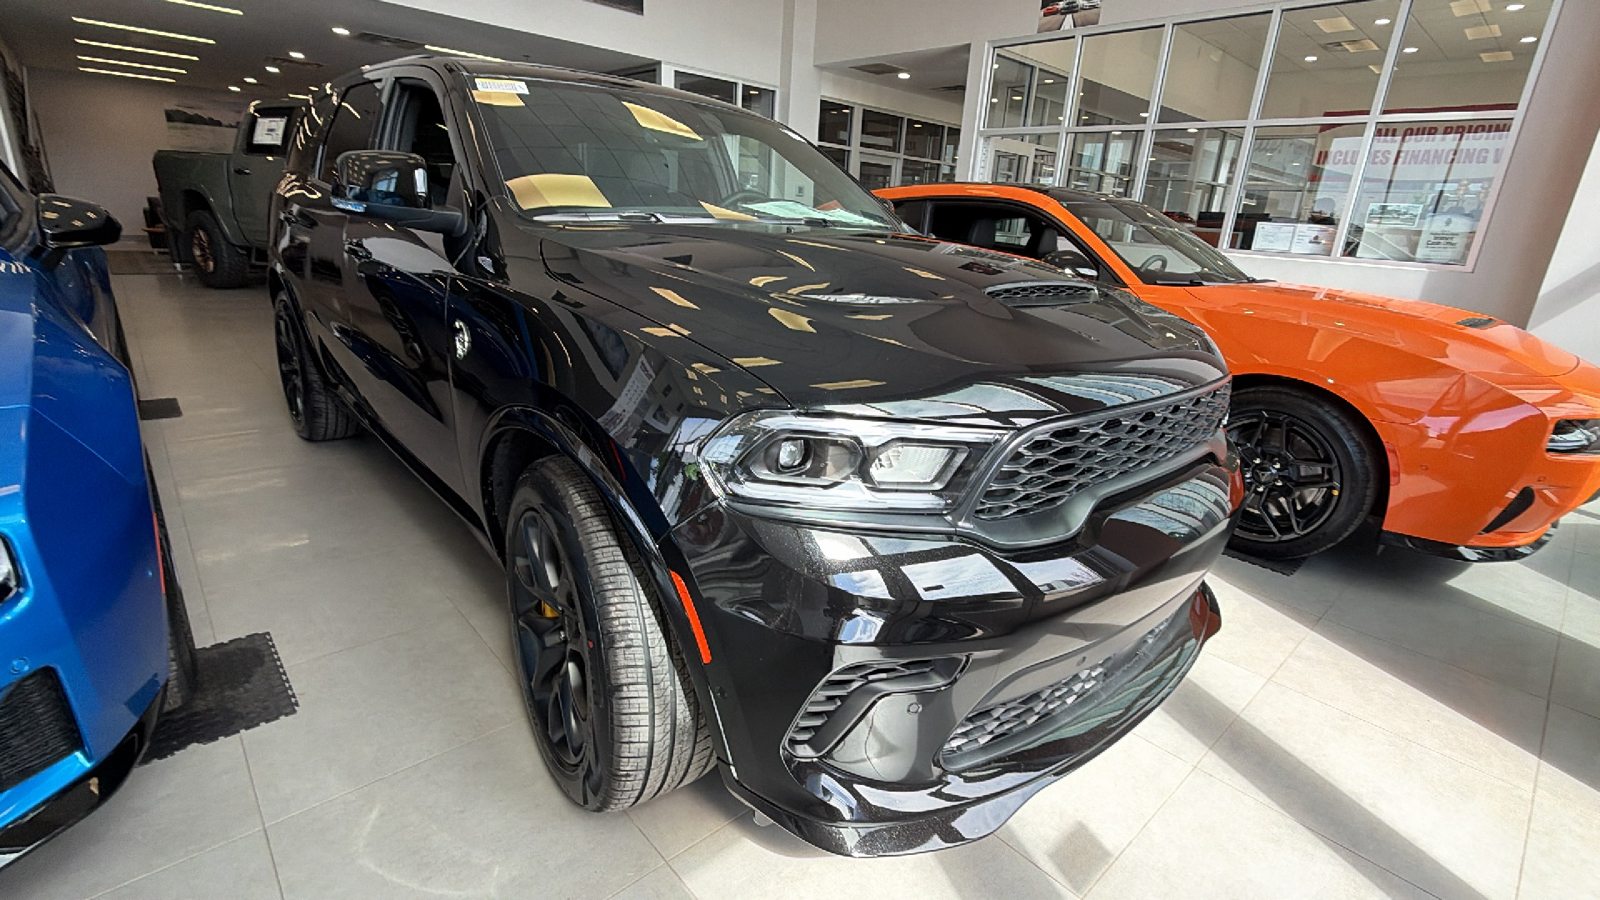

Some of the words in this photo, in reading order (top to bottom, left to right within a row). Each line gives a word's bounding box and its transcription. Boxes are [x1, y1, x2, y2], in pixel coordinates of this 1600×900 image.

[1374, 128, 1398, 143] ALL
[1401, 127, 1438, 143] OUR
[1317, 150, 1391, 165] INCLUES
[1393, 148, 1488, 165] FINANCING
